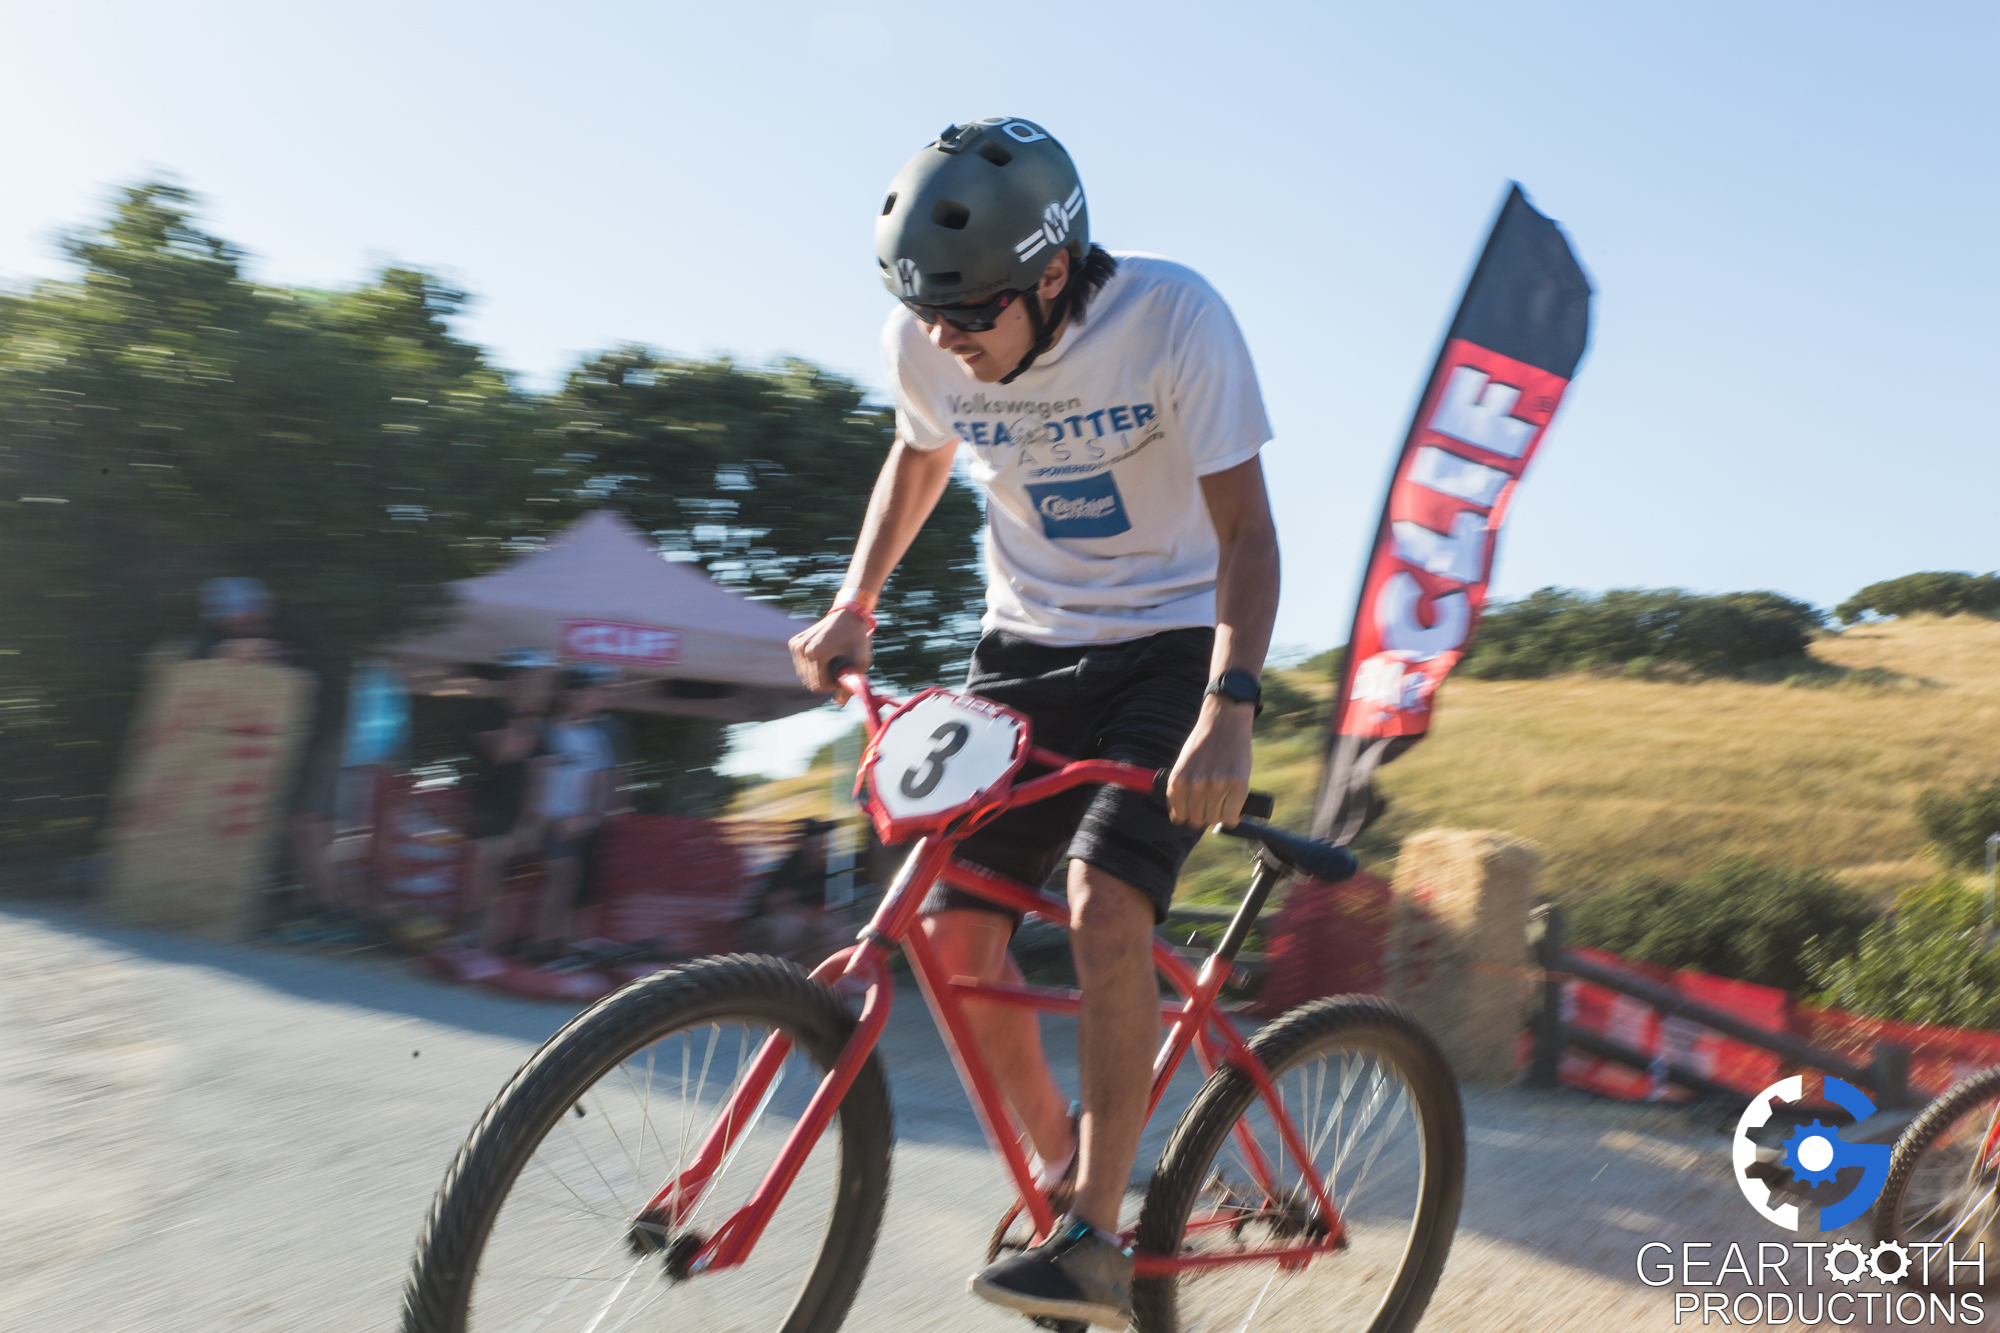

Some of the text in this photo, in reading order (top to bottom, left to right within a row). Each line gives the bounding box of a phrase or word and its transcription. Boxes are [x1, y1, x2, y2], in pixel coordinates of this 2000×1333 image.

[947, 392, 1081, 418] Volkswagen
[953, 402, 1157, 447] SEA OTTER
[1374, 362, 1540, 662] CLIF
[900, 720, 968, 799] 3
